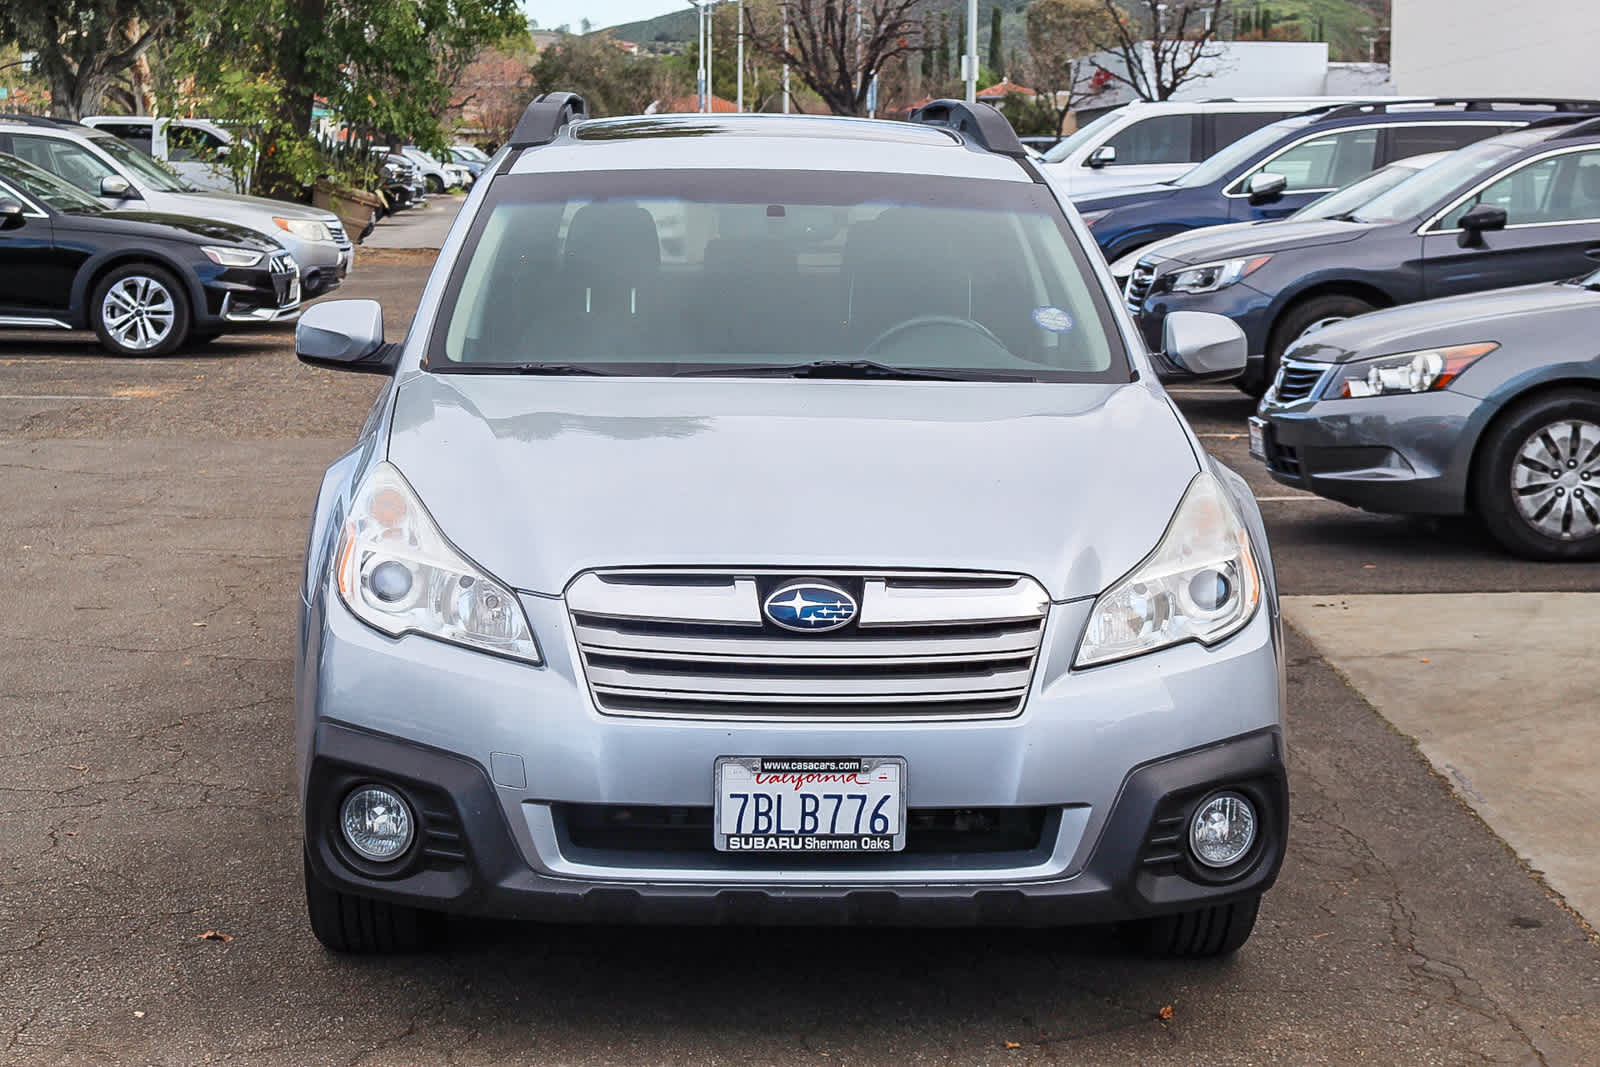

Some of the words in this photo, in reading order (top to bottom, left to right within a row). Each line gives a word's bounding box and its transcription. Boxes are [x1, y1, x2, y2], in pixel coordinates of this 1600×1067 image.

[763, 760, 859, 771] www.casacars.com
[729, 793, 892, 834] 7BLB776
[729, 837, 803, 849] SUBARU
[804, 837, 857, 849] Sherman
[861, 837, 891, 849] Oaks
